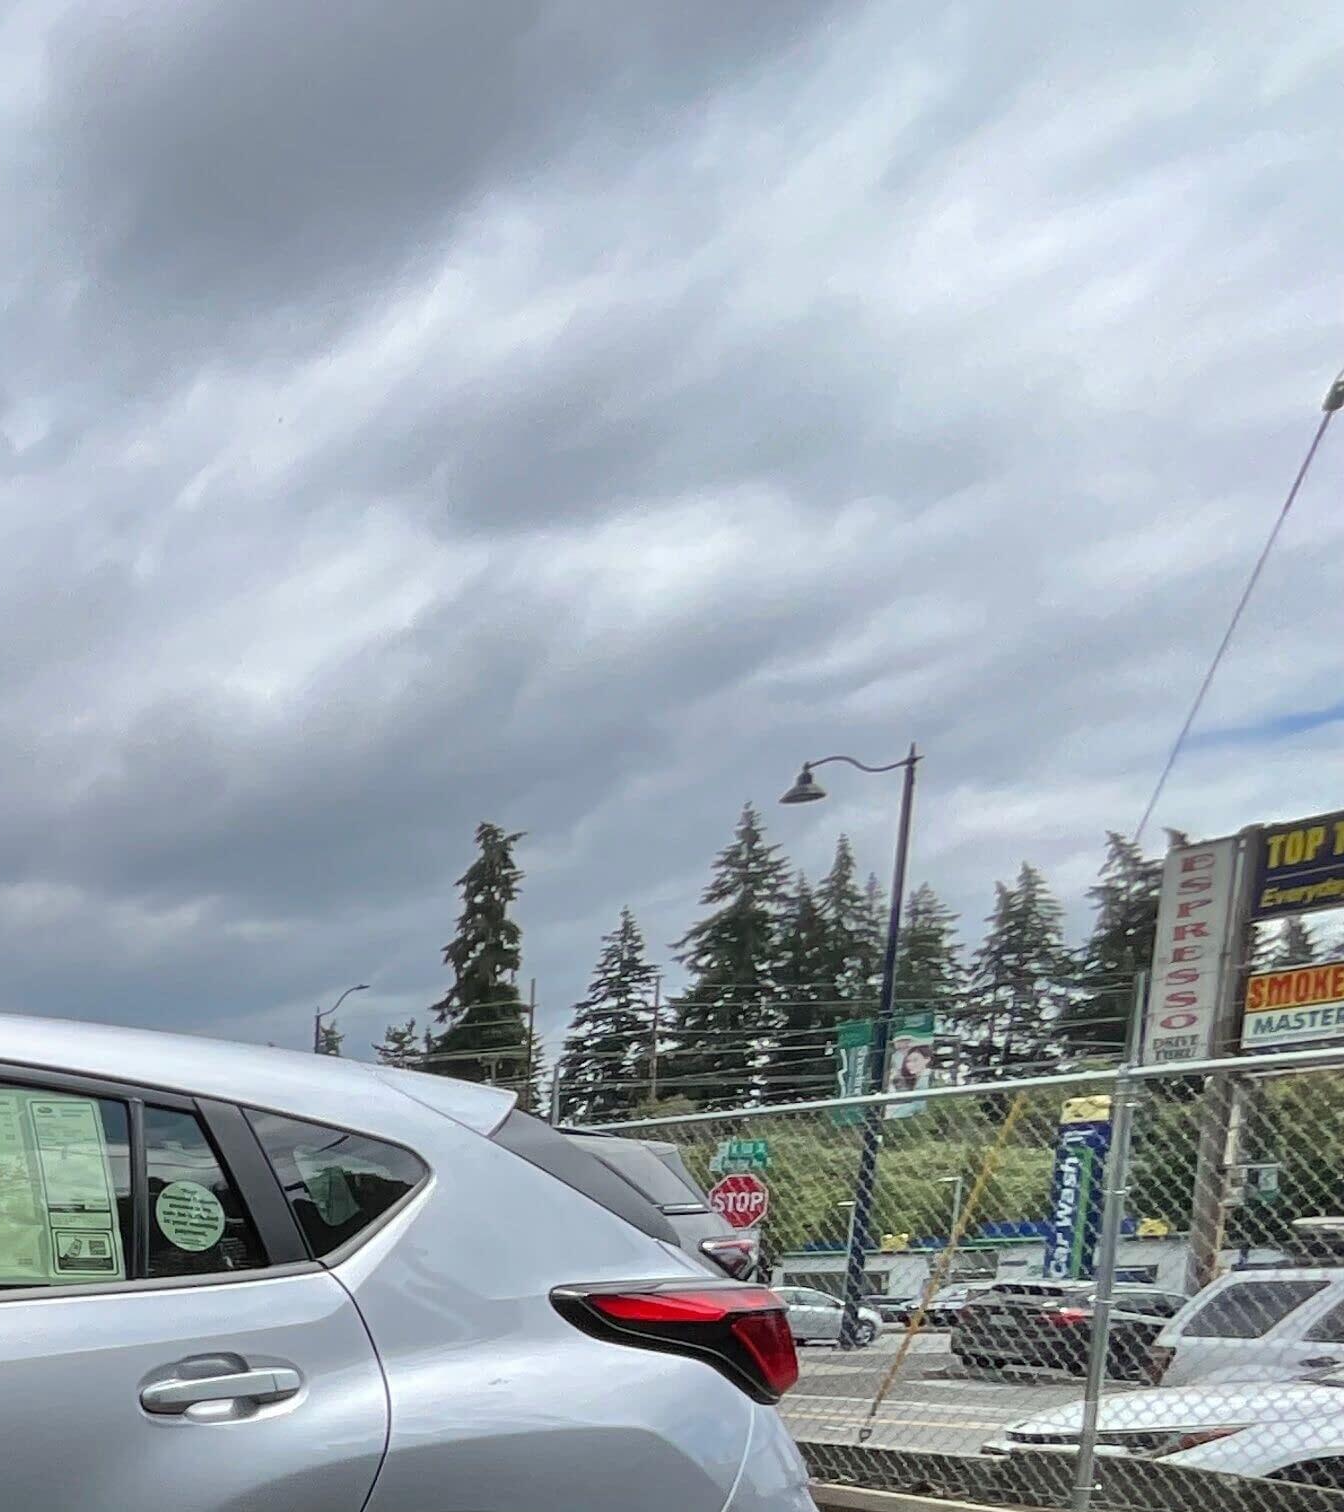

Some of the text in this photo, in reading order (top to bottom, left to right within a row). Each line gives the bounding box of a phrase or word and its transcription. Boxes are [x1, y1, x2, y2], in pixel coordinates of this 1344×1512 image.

[1267, 826, 1326, 869] TOP
[1160, 853, 1214, 1029] ESPRESSO
[1249, 966, 1344, 1010] SMOKE
[715, 1192, 764, 1213] STOP
[1056, 1156, 1082, 1227] Wash
